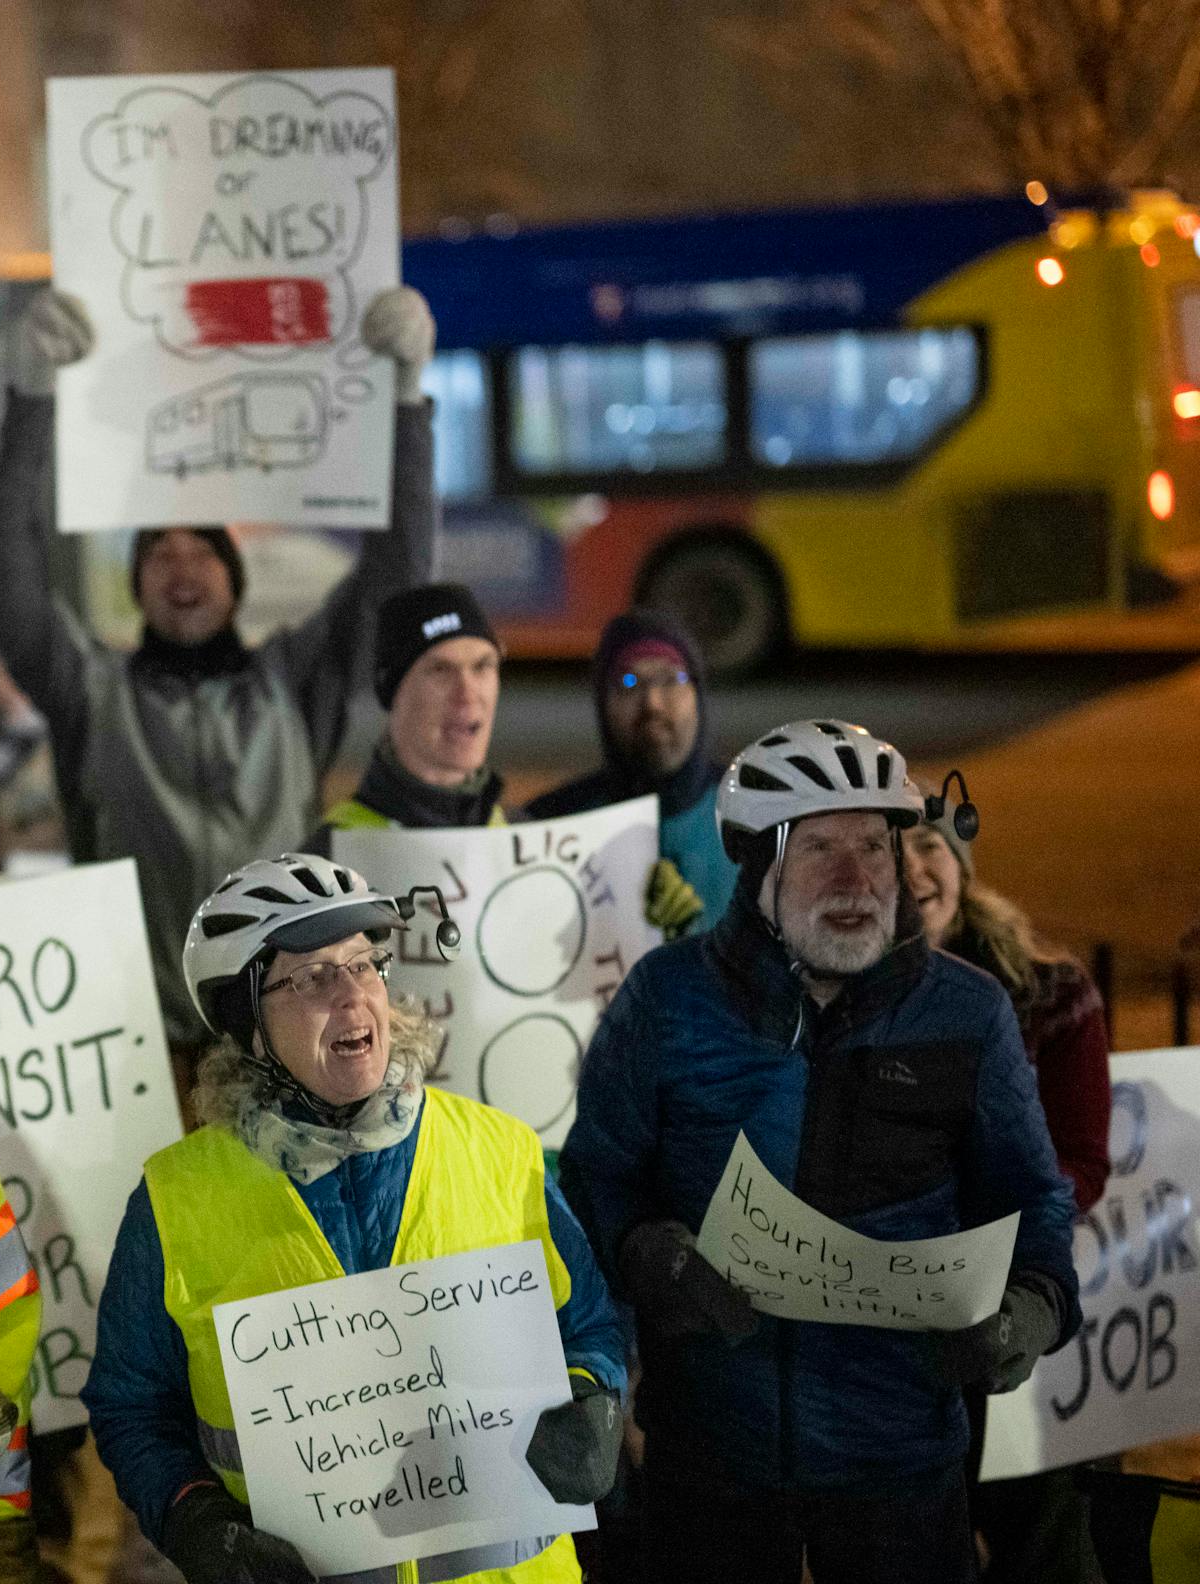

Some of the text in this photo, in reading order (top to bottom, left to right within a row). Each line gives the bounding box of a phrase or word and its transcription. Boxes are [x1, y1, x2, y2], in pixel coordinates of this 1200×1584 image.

[208, 112, 386, 160] DREAMING
[138, 201, 347, 268] LANES!
[731, 1162, 967, 1282] Hourly Bus
[1074, 1177, 1197, 1297] OUR
[728, 1233, 946, 1302] Service is
[230, 1263, 539, 1364] Cutting Service
[273, 1345, 447, 1424] Increased
[1050, 1294, 1178, 1422] JOB
[294, 1399, 514, 1475] Vehicle Miles
[305, 1455, 470, 1524] Travelled
